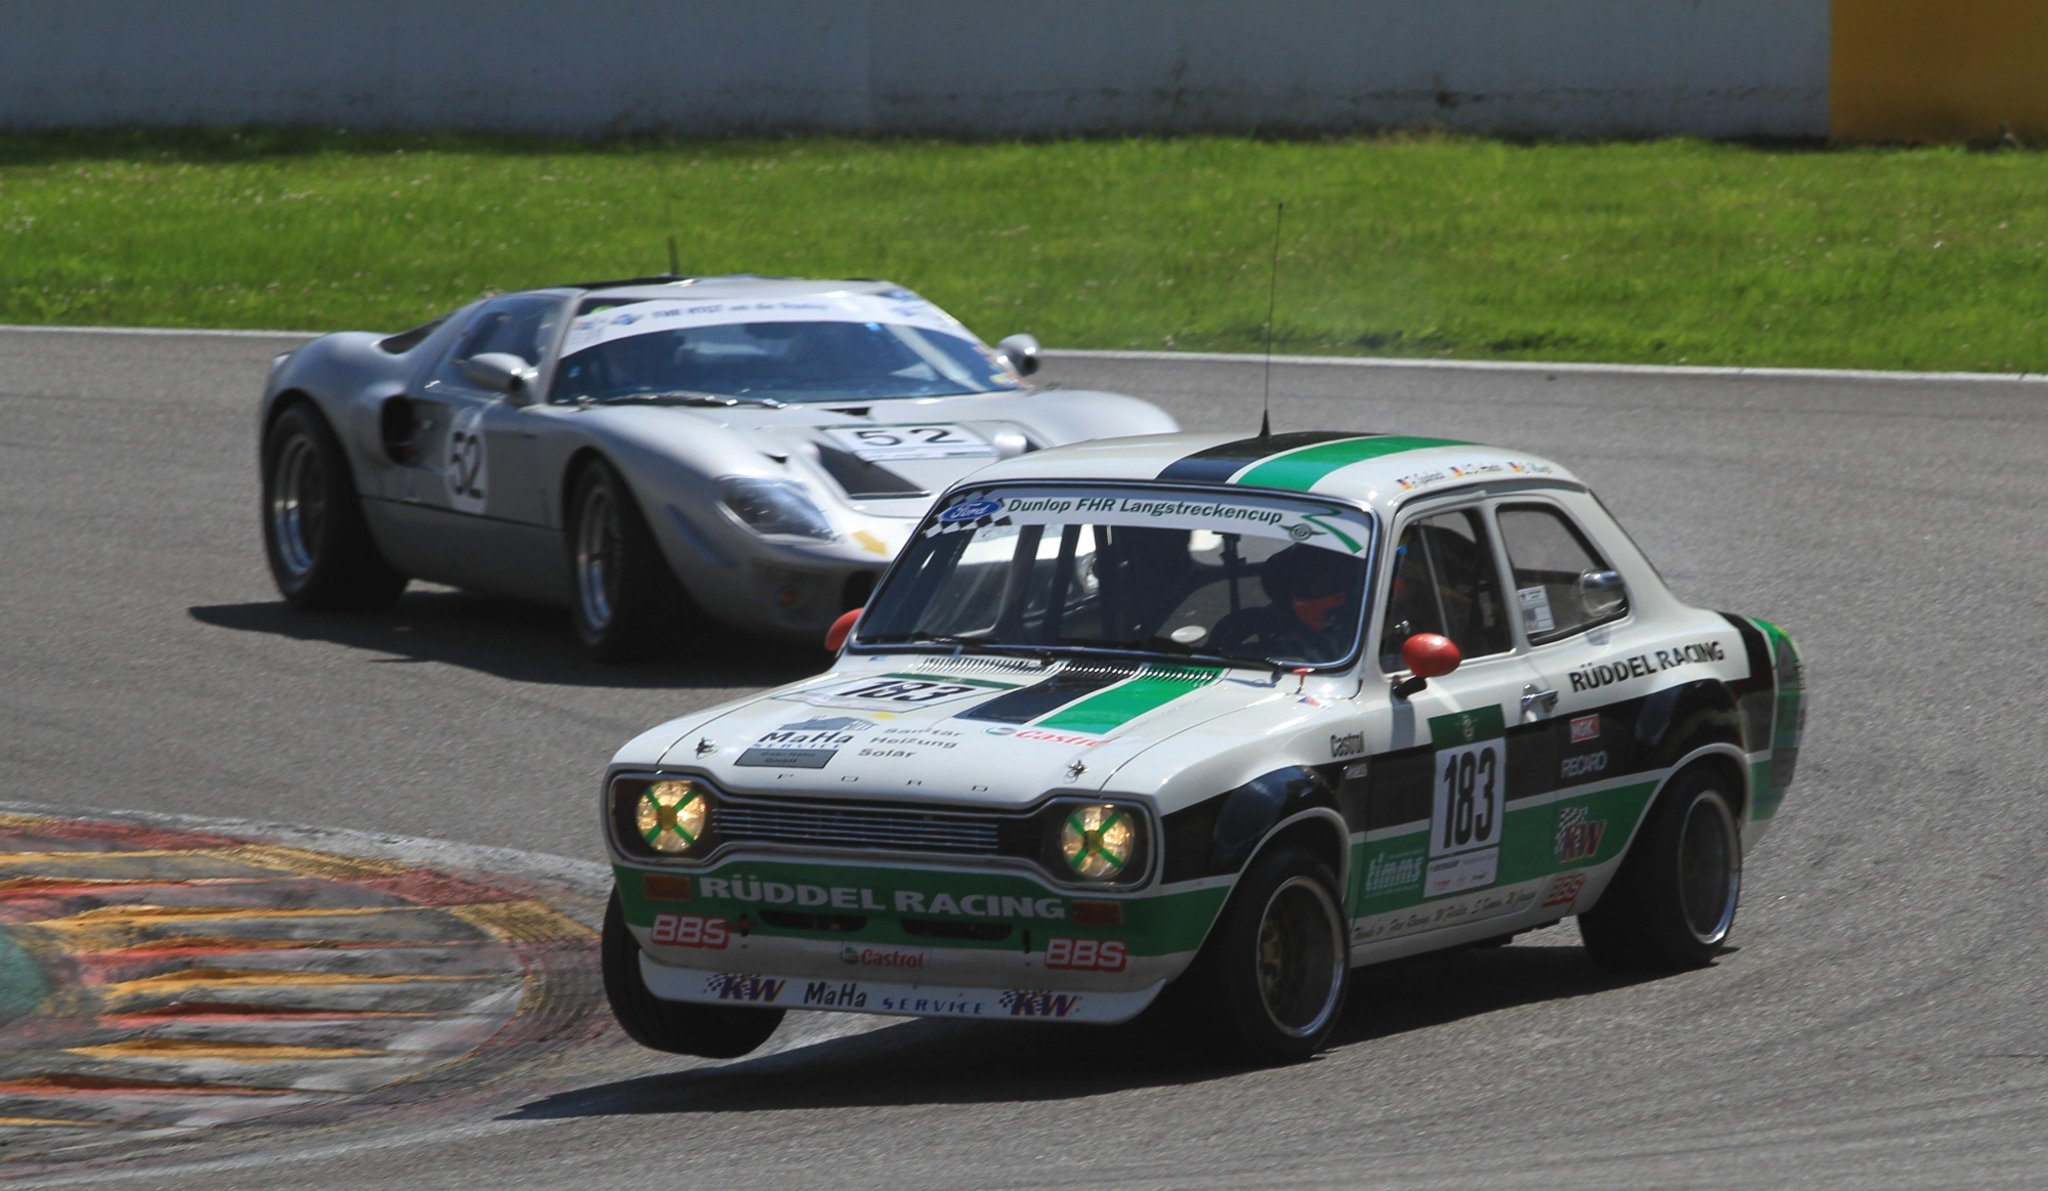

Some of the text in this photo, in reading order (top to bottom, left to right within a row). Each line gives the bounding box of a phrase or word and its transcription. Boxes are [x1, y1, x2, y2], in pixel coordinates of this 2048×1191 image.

[855, 428, 967, 446] 52
[452, 430, 483, 500] 52
[950, 502, 991, 518] Ford
[1008, 498, 1283, 524] Dunlop FHR Langstreckencup
[1568, 641, 1725, 692] RÜDDEL RACING
[836, 680, 977, 701] 183
[758, 731, 854, 744] MaHa
[1330, 731, 1365, 758] Castrol
[858, 749, 917, 758] Solar
[1561, 751, 1608, 778] RECARO
[1443, 747, 1496, 849] 183
[700, 874, 1066, 919] RÜDDEL RACING
[652, 914, 727, 946] BBS
[860, 948, 924, 968] Castrol
[1046, 938, 1125, 969] BBS
[718, 974, 786, 1002] KW
[803, 981, 986, 1015] MaHa SERVICE
[1009, 992, 1077, 1018] KW
